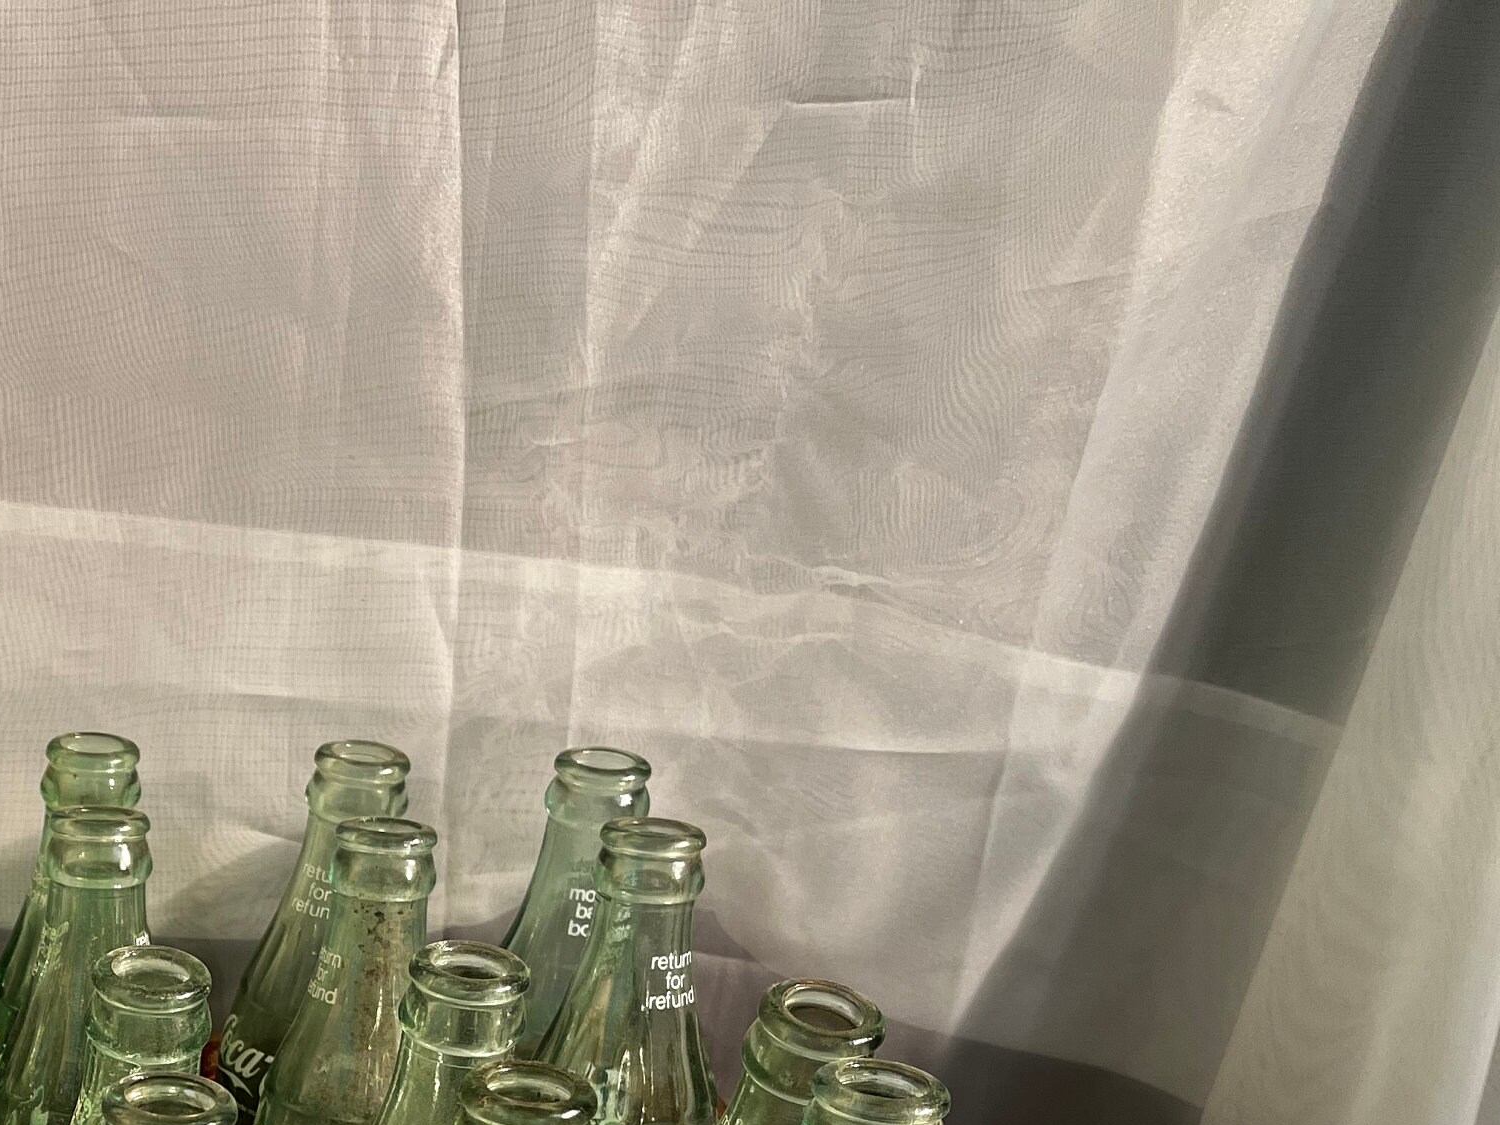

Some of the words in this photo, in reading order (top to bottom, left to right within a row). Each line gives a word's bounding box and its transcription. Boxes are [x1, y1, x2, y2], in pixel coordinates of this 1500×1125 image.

[303, 863, 332, 884] retu
[309, 881, 332, 902] for
[292, 897, 330, 920] refun
[651, 950, 692, 970] return
[666, 971, 686, 990] for
[649, 985, 695, 1010] refund
